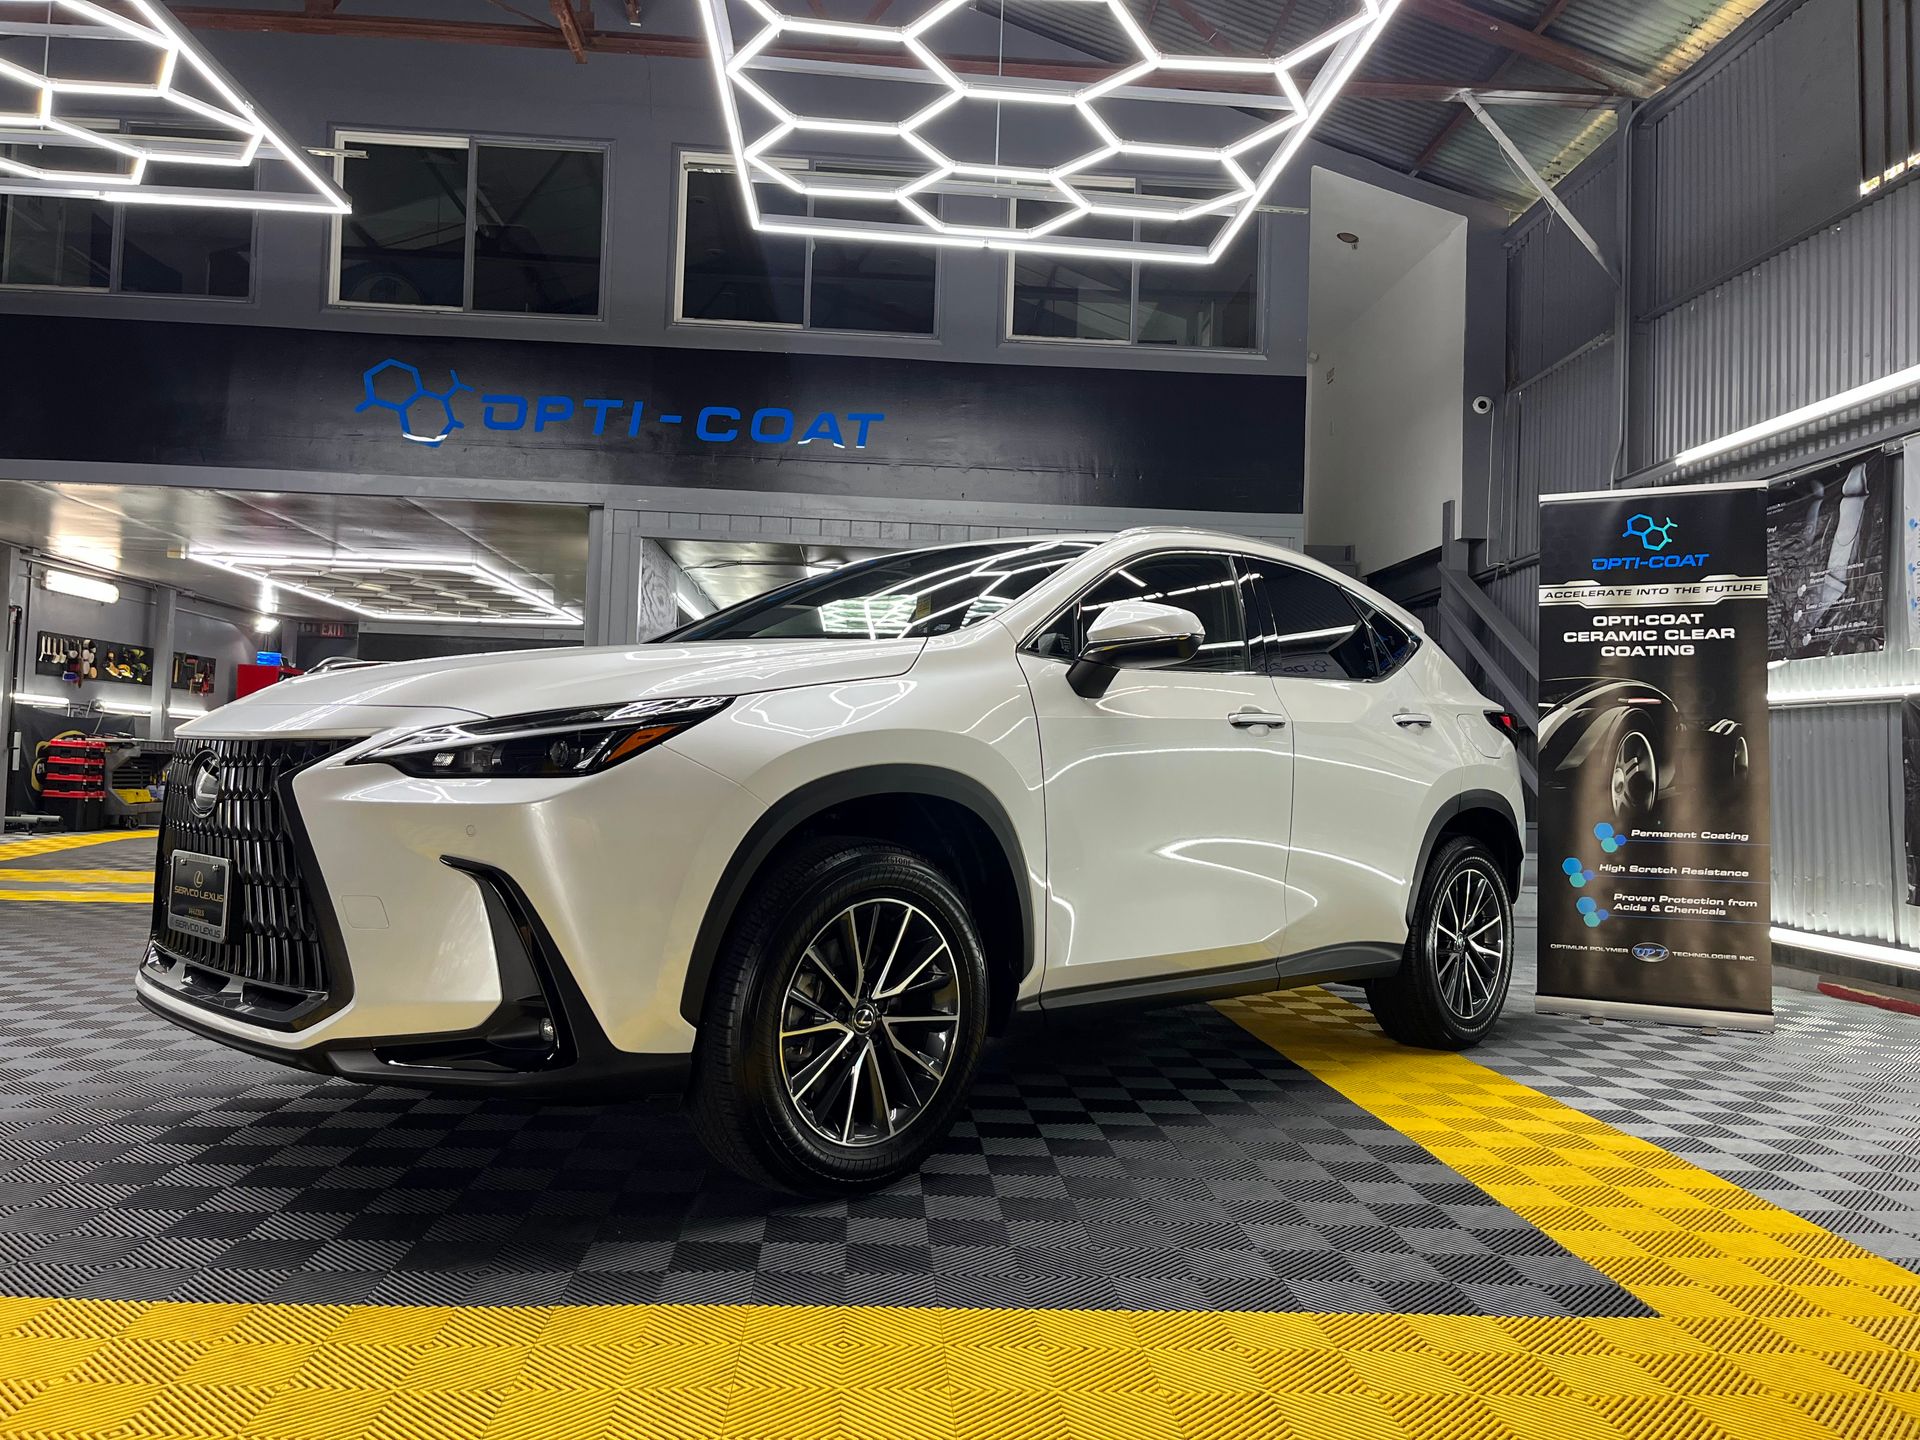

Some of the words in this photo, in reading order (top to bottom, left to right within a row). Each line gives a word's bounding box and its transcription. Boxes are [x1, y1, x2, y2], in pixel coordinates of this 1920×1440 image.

[482, 395, 884, 449] OPTI-COAT
[1592, 554, 1710, 571] OPTI-COAT
[1544, 588, 1632, 599] ACCELERATE
[1636, 587, 1669, 596] INTO
[1674, 586, 1700, 594] THE
[1706, 583, 1763, 593] FUTURE
[1592, 613, 1704, 627] OPTI-COAT
[1563, 630, 1658, 643] CERAMIC
[1664, 628, 1736, 640] CLEAR
[1600, 645, 1695, 657] COATING
[1631, 829, 1697, 839] Permanent
[1701, 831, 1749, 842] Coating
[1599, 863, 1626, 873] High
[1629, 865, 1678, 875] Scratch
[1681, 867, 1749, 877] Resistance
[174, 886, 199, 897] SERVCO
[200, 891, 224, 902] LEXUS
[1613, 893, 1656, 903] Proven
[1659, 895, 1724, 906] Protection
[1728, 898, 1758, 907] from
[1613, 903, 1647, 912] Acids
[1651, 904, 1661, 912] &
[1664, 905, 1726, 916] Chemicals
[200, 926, 221, 938] LEXUS
[1550, 943, 1588, 951] OPTIMUM
[1672, 951, 1738, 960] TECHNOLOGIES
